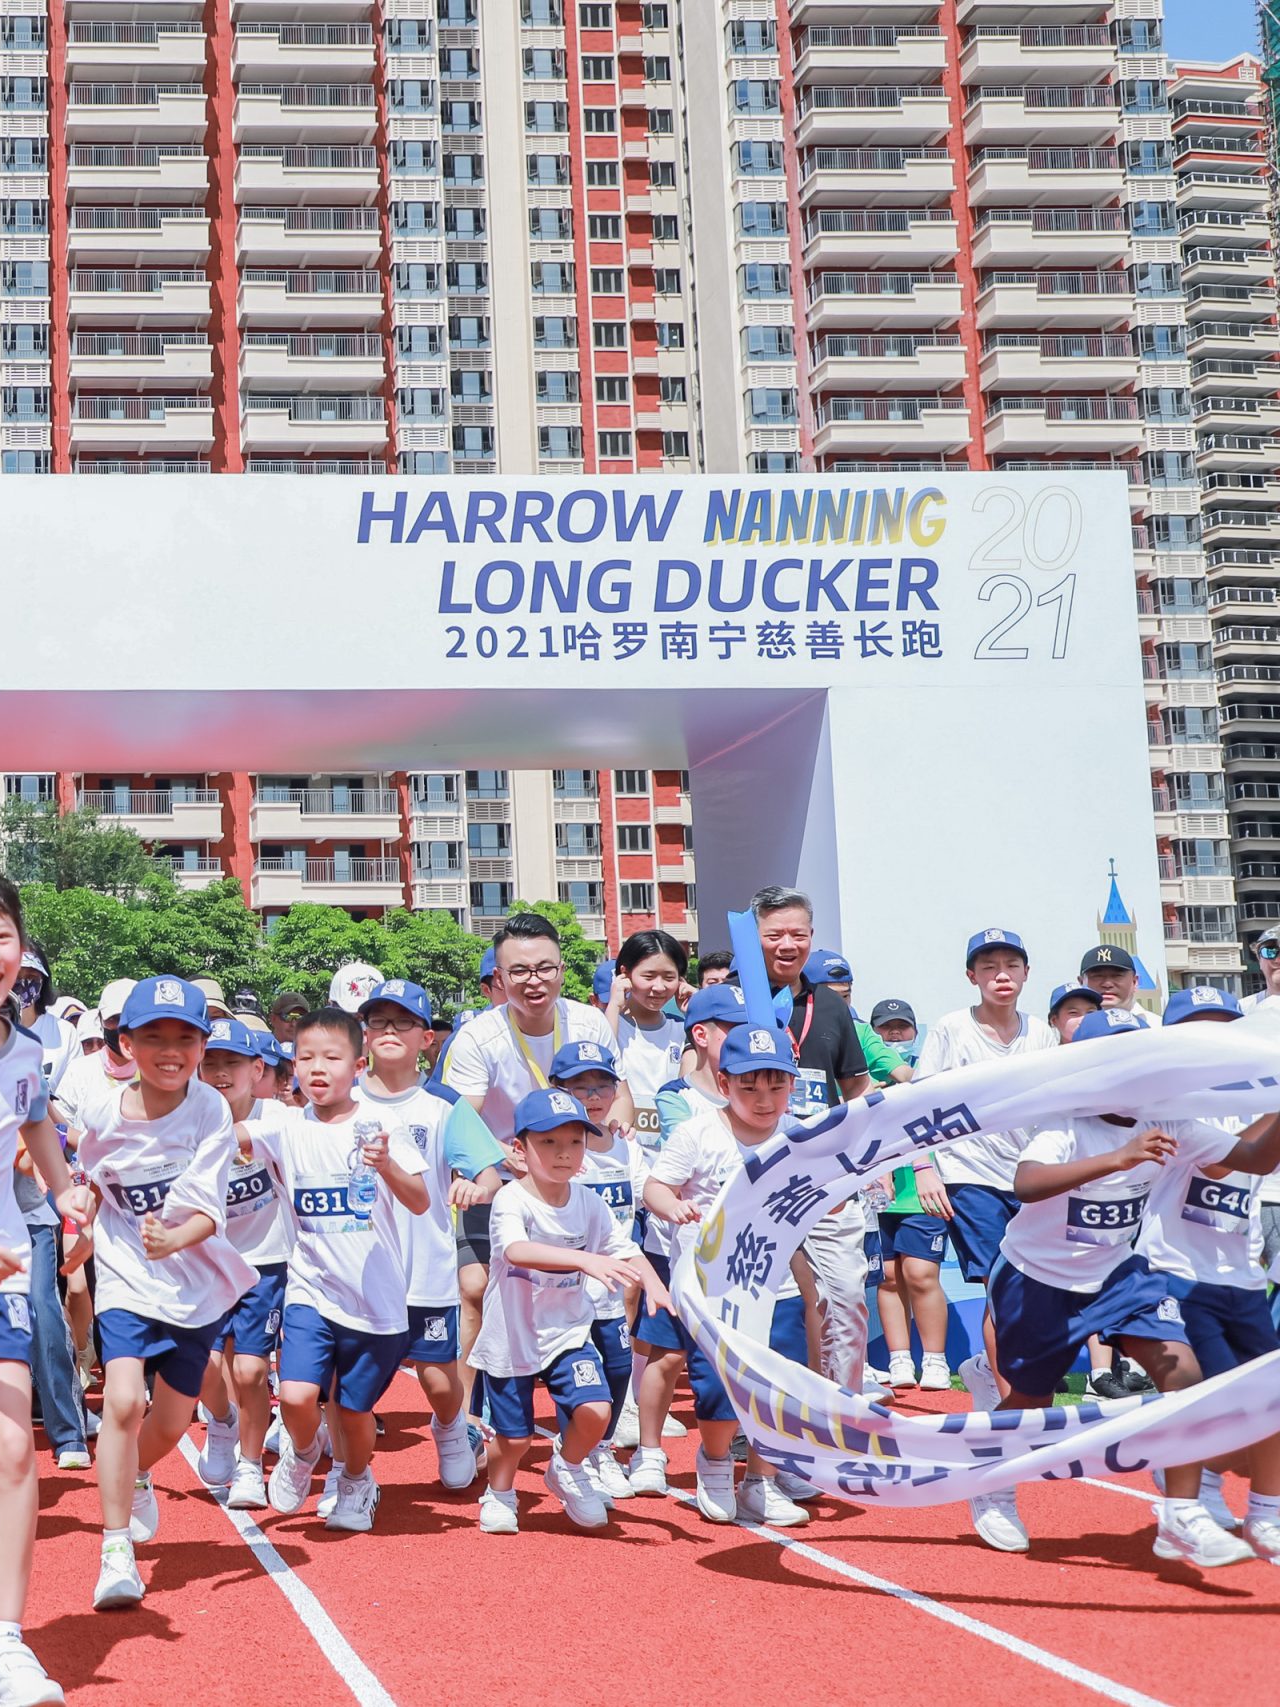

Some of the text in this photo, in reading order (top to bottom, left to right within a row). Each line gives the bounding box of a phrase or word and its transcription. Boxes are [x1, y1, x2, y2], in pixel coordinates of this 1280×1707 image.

[357, 486, 947, 548] HARROW NANNING
[968, 485, 1082, 571] 20
[438, 558, 940, 614] LONG DUCKER
[445, 620, 943, 661] 2021哈罗南宁慈善长跑
[974, 573, 1076, 659] 21
[301, 1191, 346, 1213] G31
